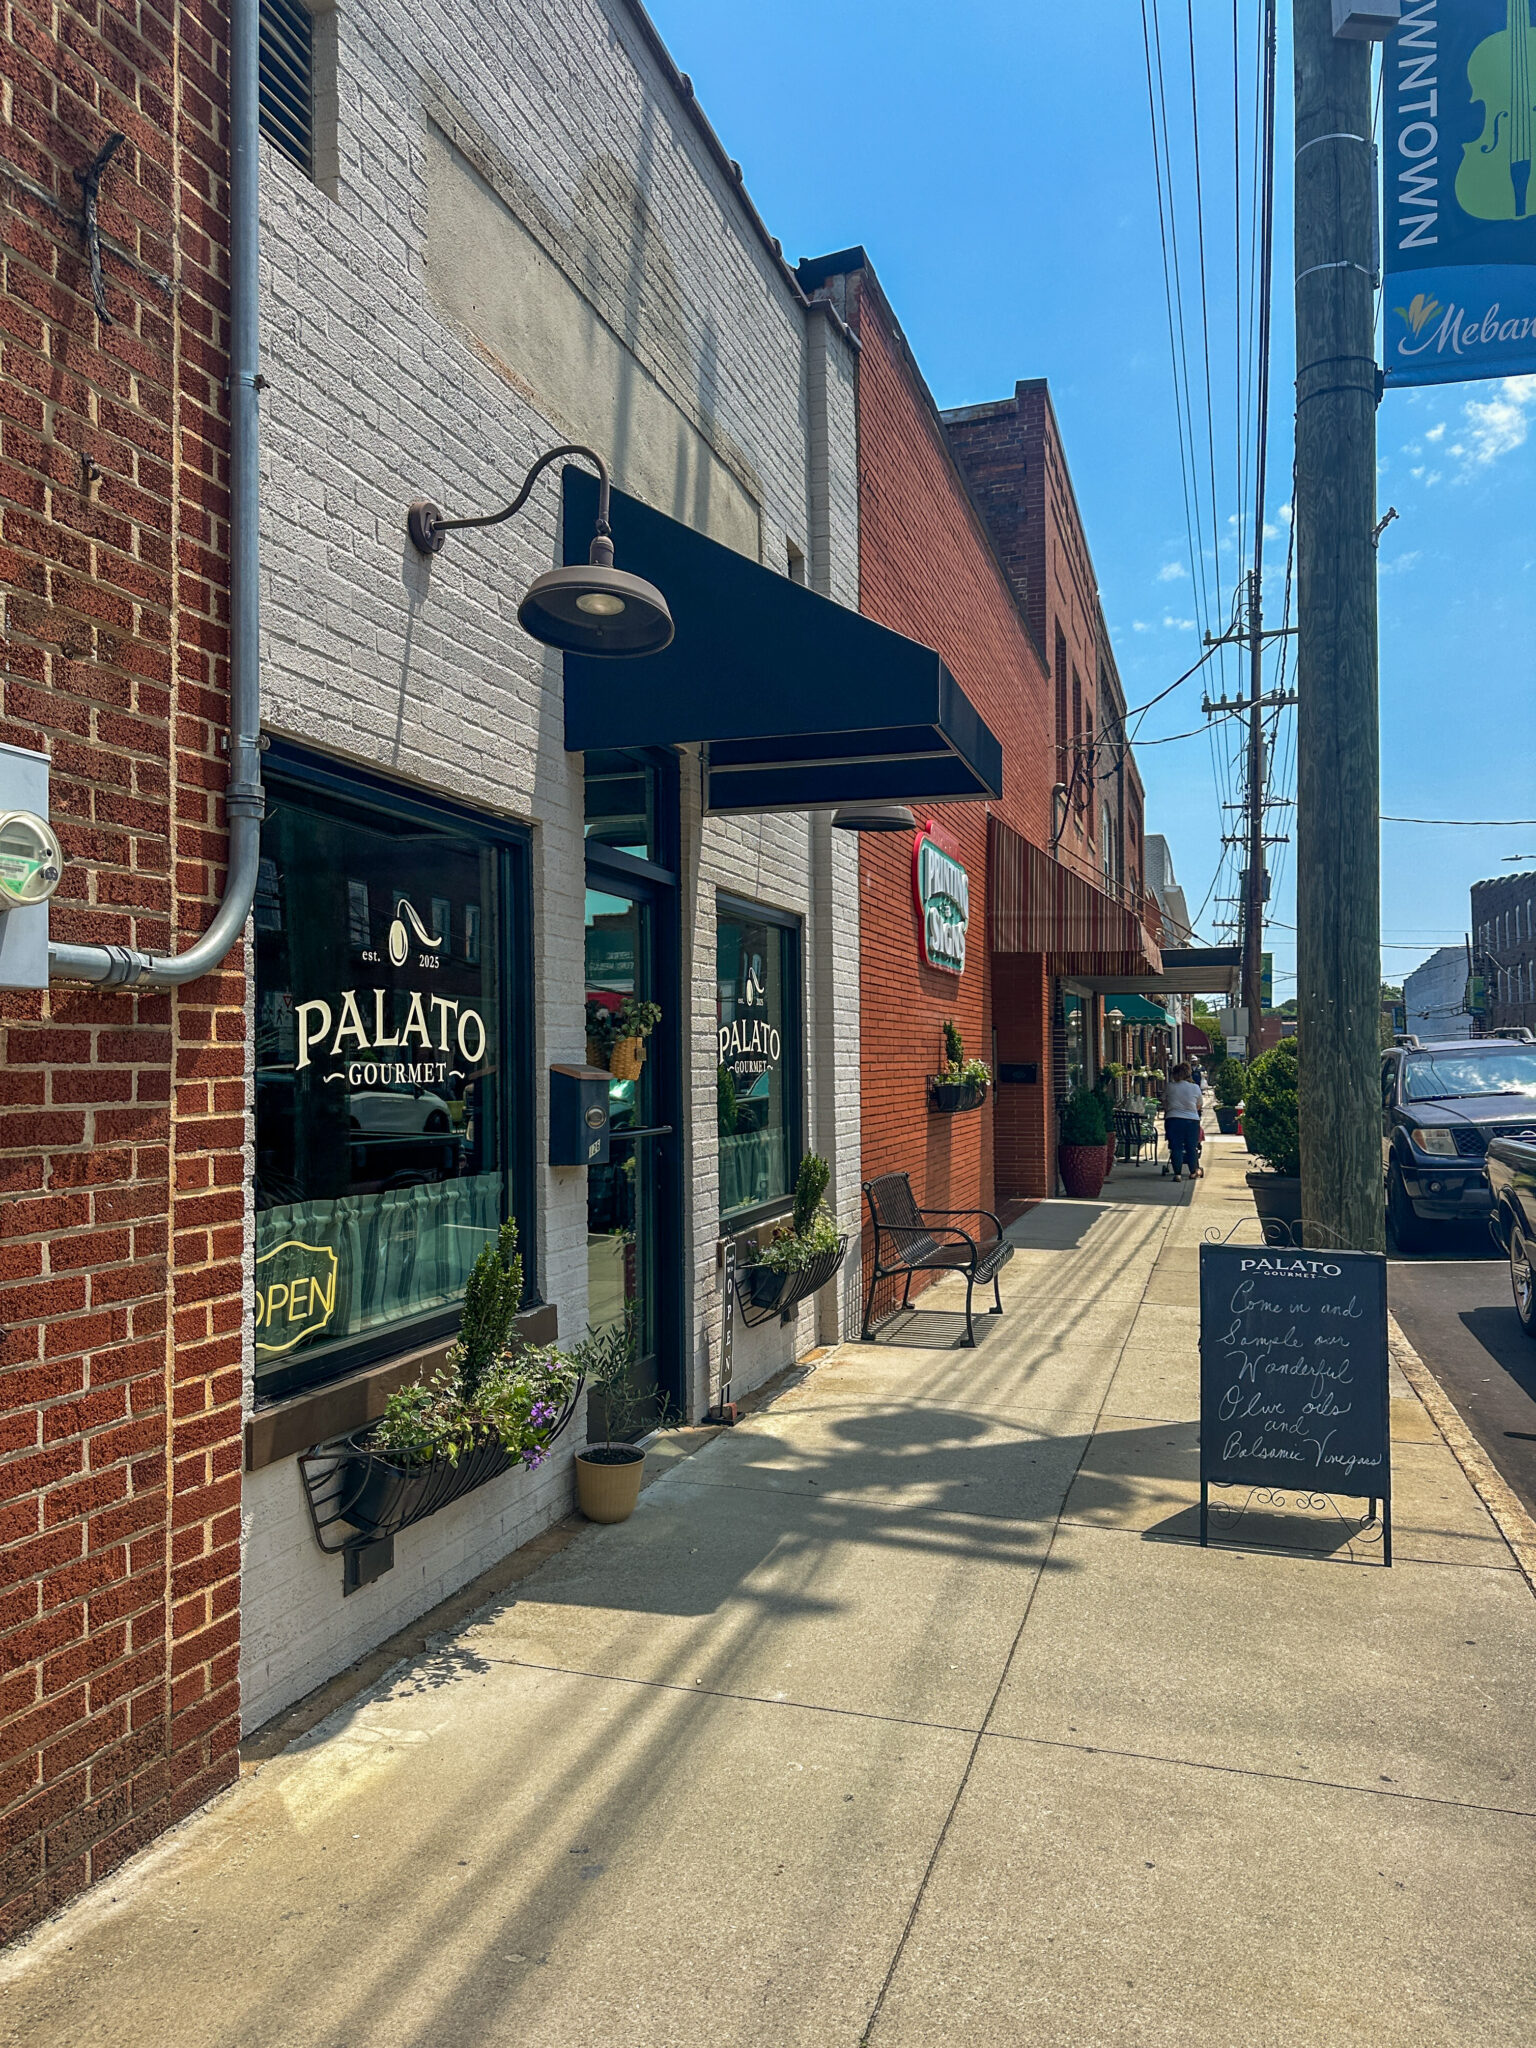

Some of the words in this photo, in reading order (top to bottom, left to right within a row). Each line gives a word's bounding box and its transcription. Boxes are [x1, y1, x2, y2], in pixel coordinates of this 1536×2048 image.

[1398, 0, 1438, 250] WNTOWN
[924, 847, 969, 919] PRINTING
[929, 906, 966, 961] SIGNS
[362, 950, 381, 962] est.
[419, 954, 440, 969] 2025
[294, 988, 486, 1071] PALATO
[718, 1019, 781, 1065] PALATO
[348, 1062, 447, 1086] GOURMET
[734, 1060, 767, 1074] GOURMET
[1240, 1258, 1342, 1276] PALATO
[1263, 1270, 1317, 1279] GOURMET
[1230, 1279, 1283, 1314] Come
[1289, 1302, 1311, 1314] in
[1320, 1295, 1363, 1318] and
[1215, 1318, 1304, 1355] Sample
[1313, 1334, 1350, 1348] our
[1223, 1350, 1353, 1399] Wonderful
[1218, 1385, 1286, 1421] Olive
[1301, 1392, 1352, 1417] oils
[1264, 1416, 1309, 1436] and
[1222, 1430, 1305, 1461] Balsamic
